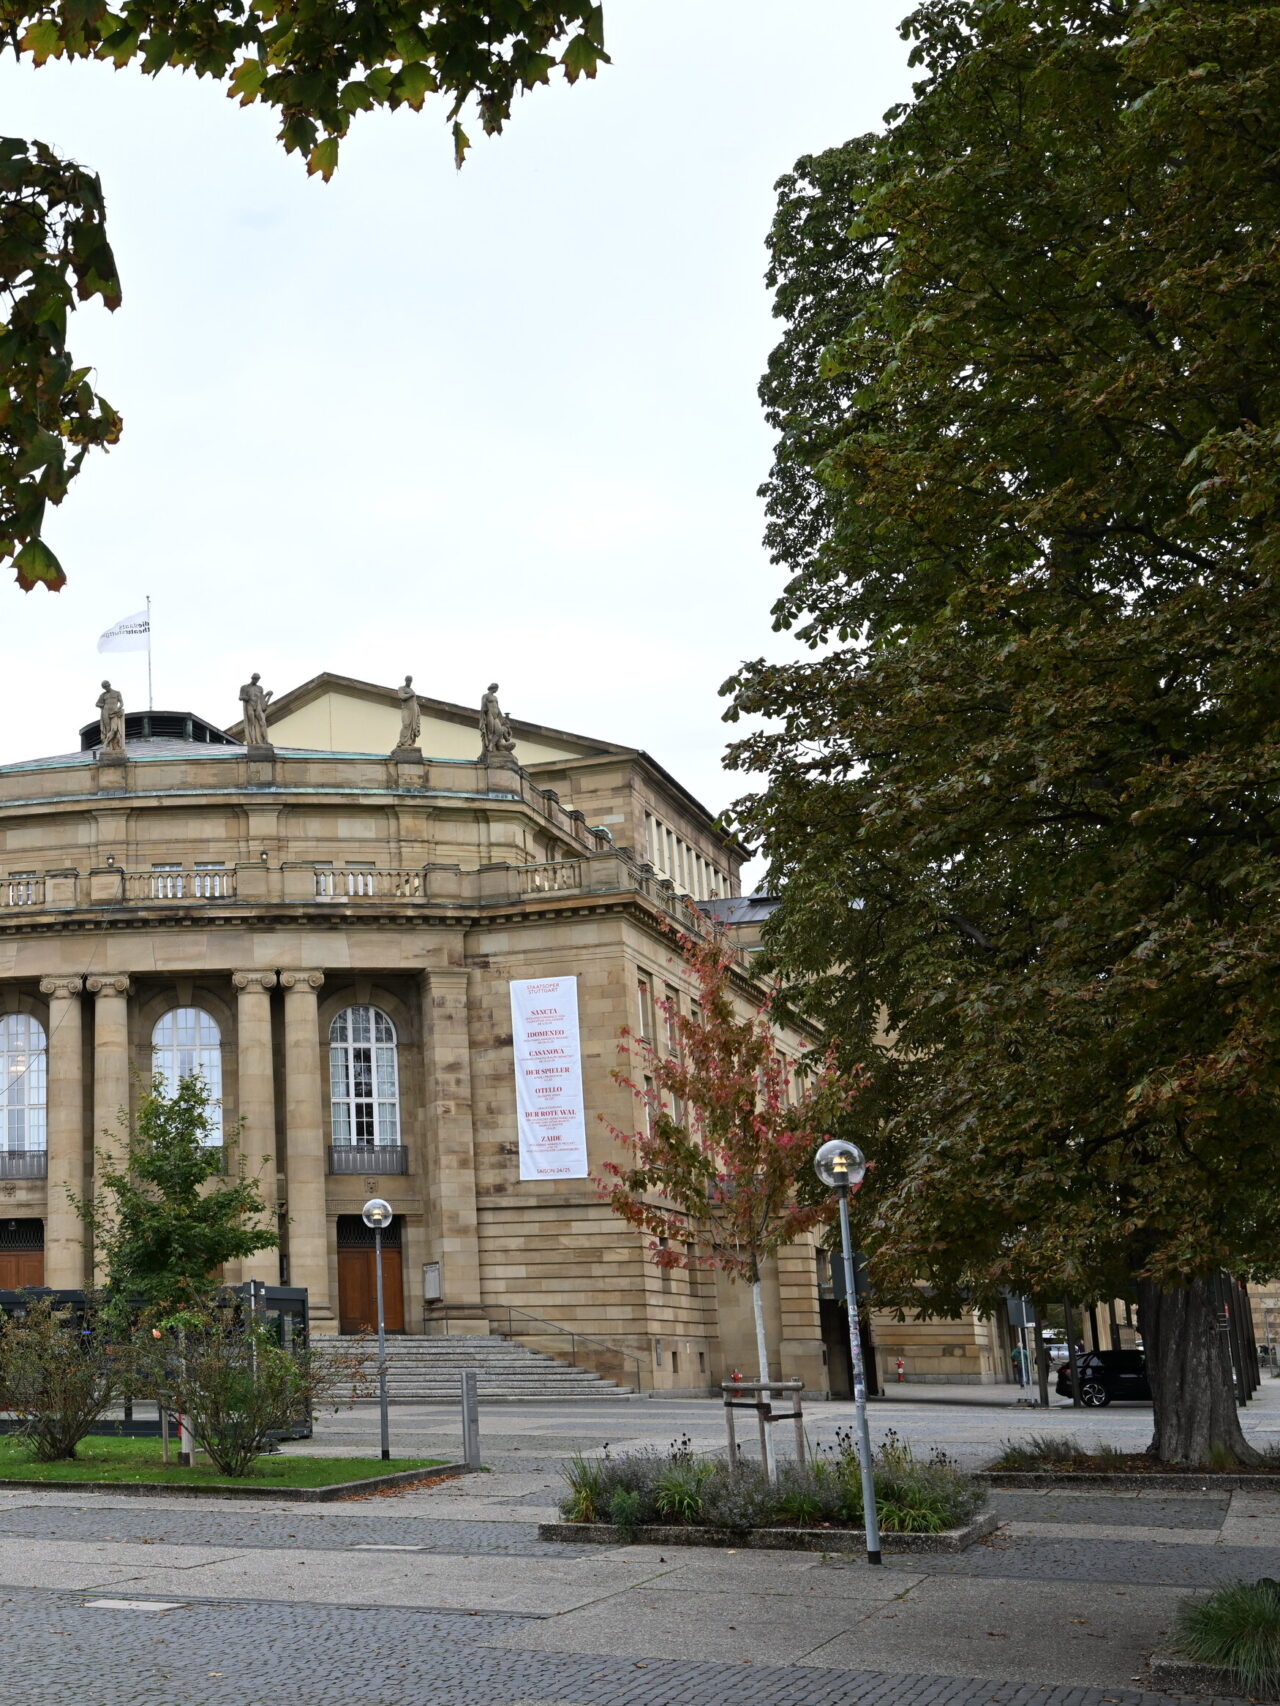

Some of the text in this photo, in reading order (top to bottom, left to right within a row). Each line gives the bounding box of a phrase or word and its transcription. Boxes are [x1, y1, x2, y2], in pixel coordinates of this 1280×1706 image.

[526, 982, 560, 990] STAATSOPER
[528, 987, 558, 995] STUTTGART
[530, 1008, 558, 1016] SANCTA
[527, 1029, 565, 1038] IDOMENEO
[528, 1048, 565, 1057] CASANOVA
[525, 1066, 570, 1076] DER SPIELER
[534, 1086, 563, 1094] OTELLO
[541, 1135, 563, 1143] ZAIDE
